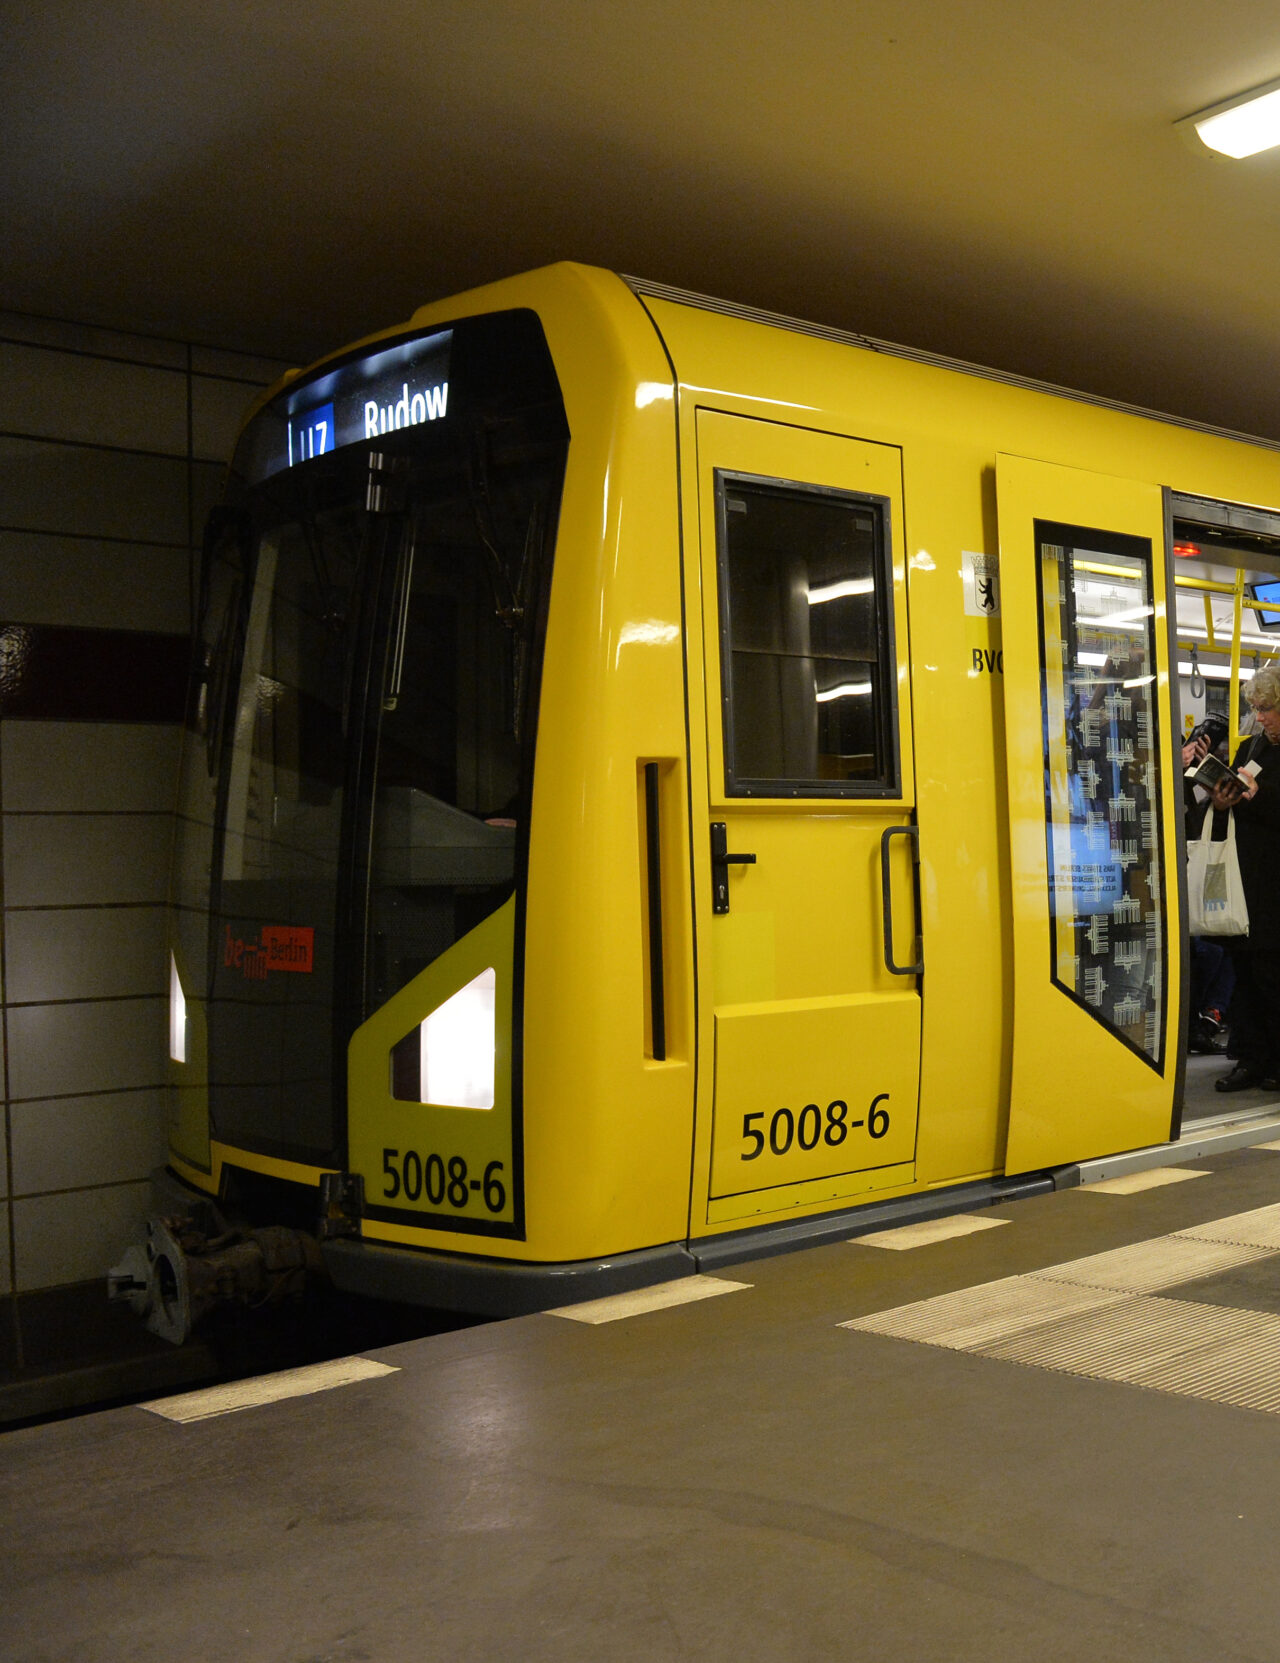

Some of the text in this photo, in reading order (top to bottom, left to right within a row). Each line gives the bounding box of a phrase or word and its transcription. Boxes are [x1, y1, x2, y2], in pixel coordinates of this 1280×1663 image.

[364, 382, 449, 439] Rudow
[270, 936, 308, 963] Berlin
[740, 1093, 890, 1161] 5008-6
[383, 1147, 506, 1213] 5008-6
